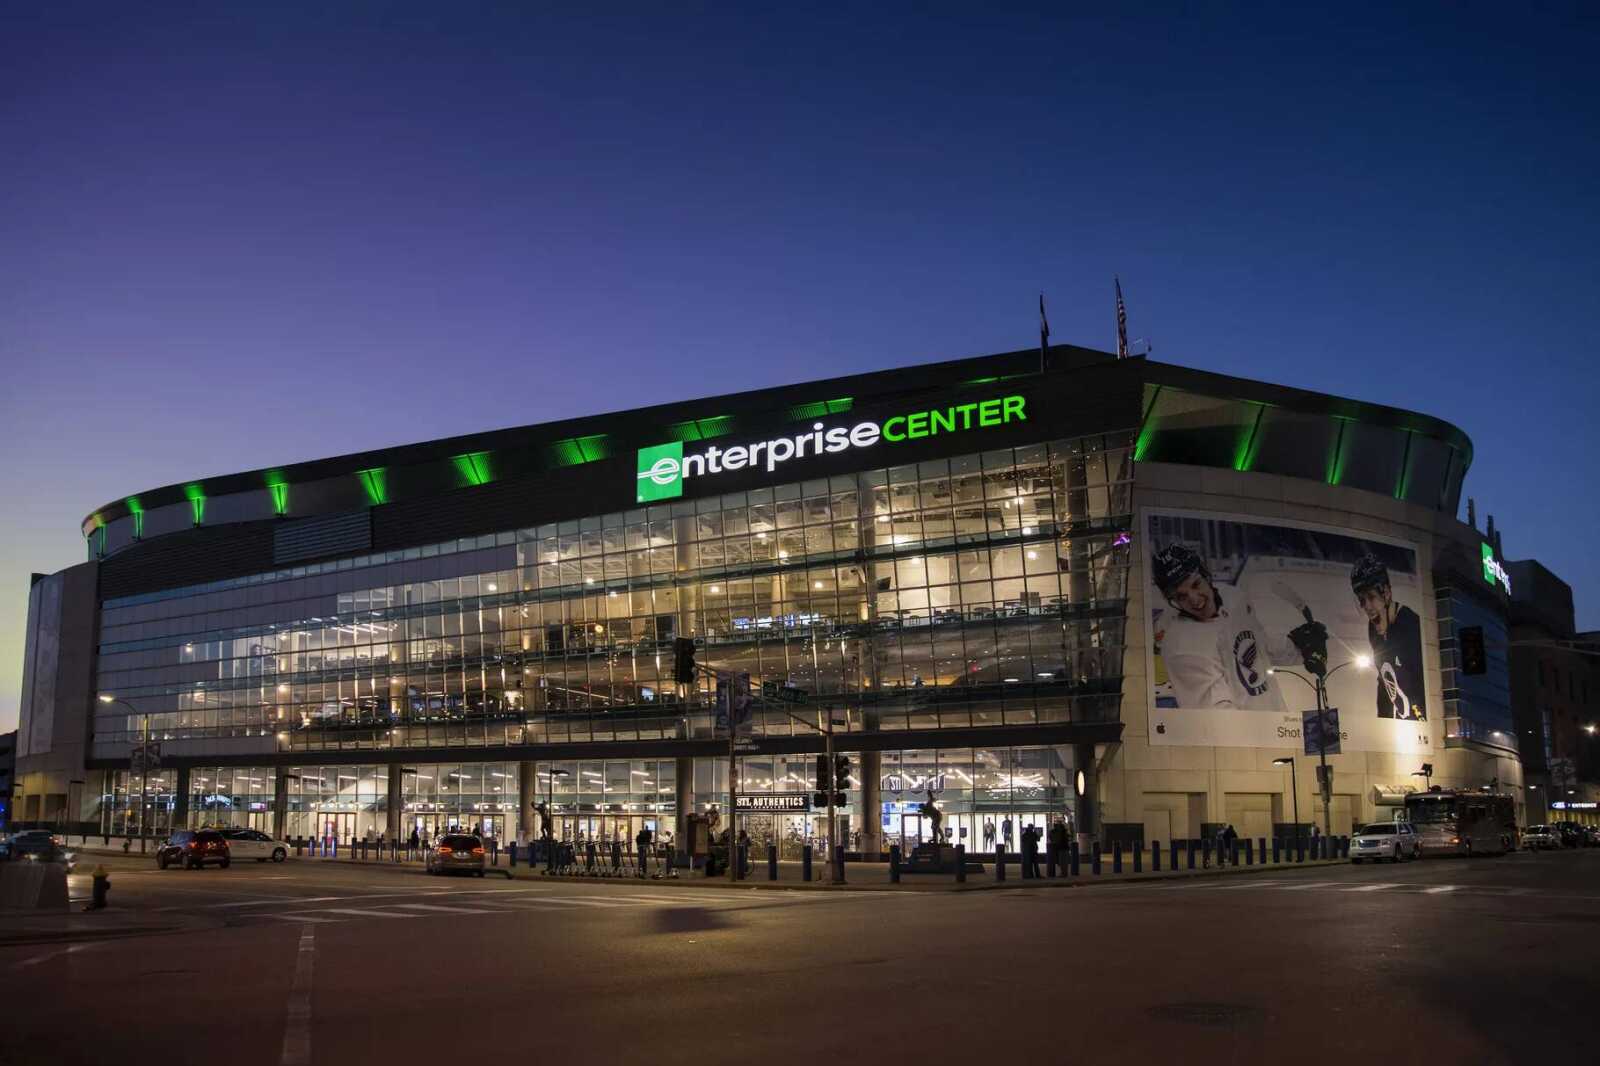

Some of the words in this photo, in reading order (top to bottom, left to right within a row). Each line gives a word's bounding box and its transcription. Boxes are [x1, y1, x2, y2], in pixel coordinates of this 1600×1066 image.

[637, 421, 881, 485] enterprise
[882, 395, 1027, 442] CENTER
[1277, 726, 1301, 738] Shot
[736, 797, 752, 806] STL
[753, 796, 804, 806] AUTHENTICS
